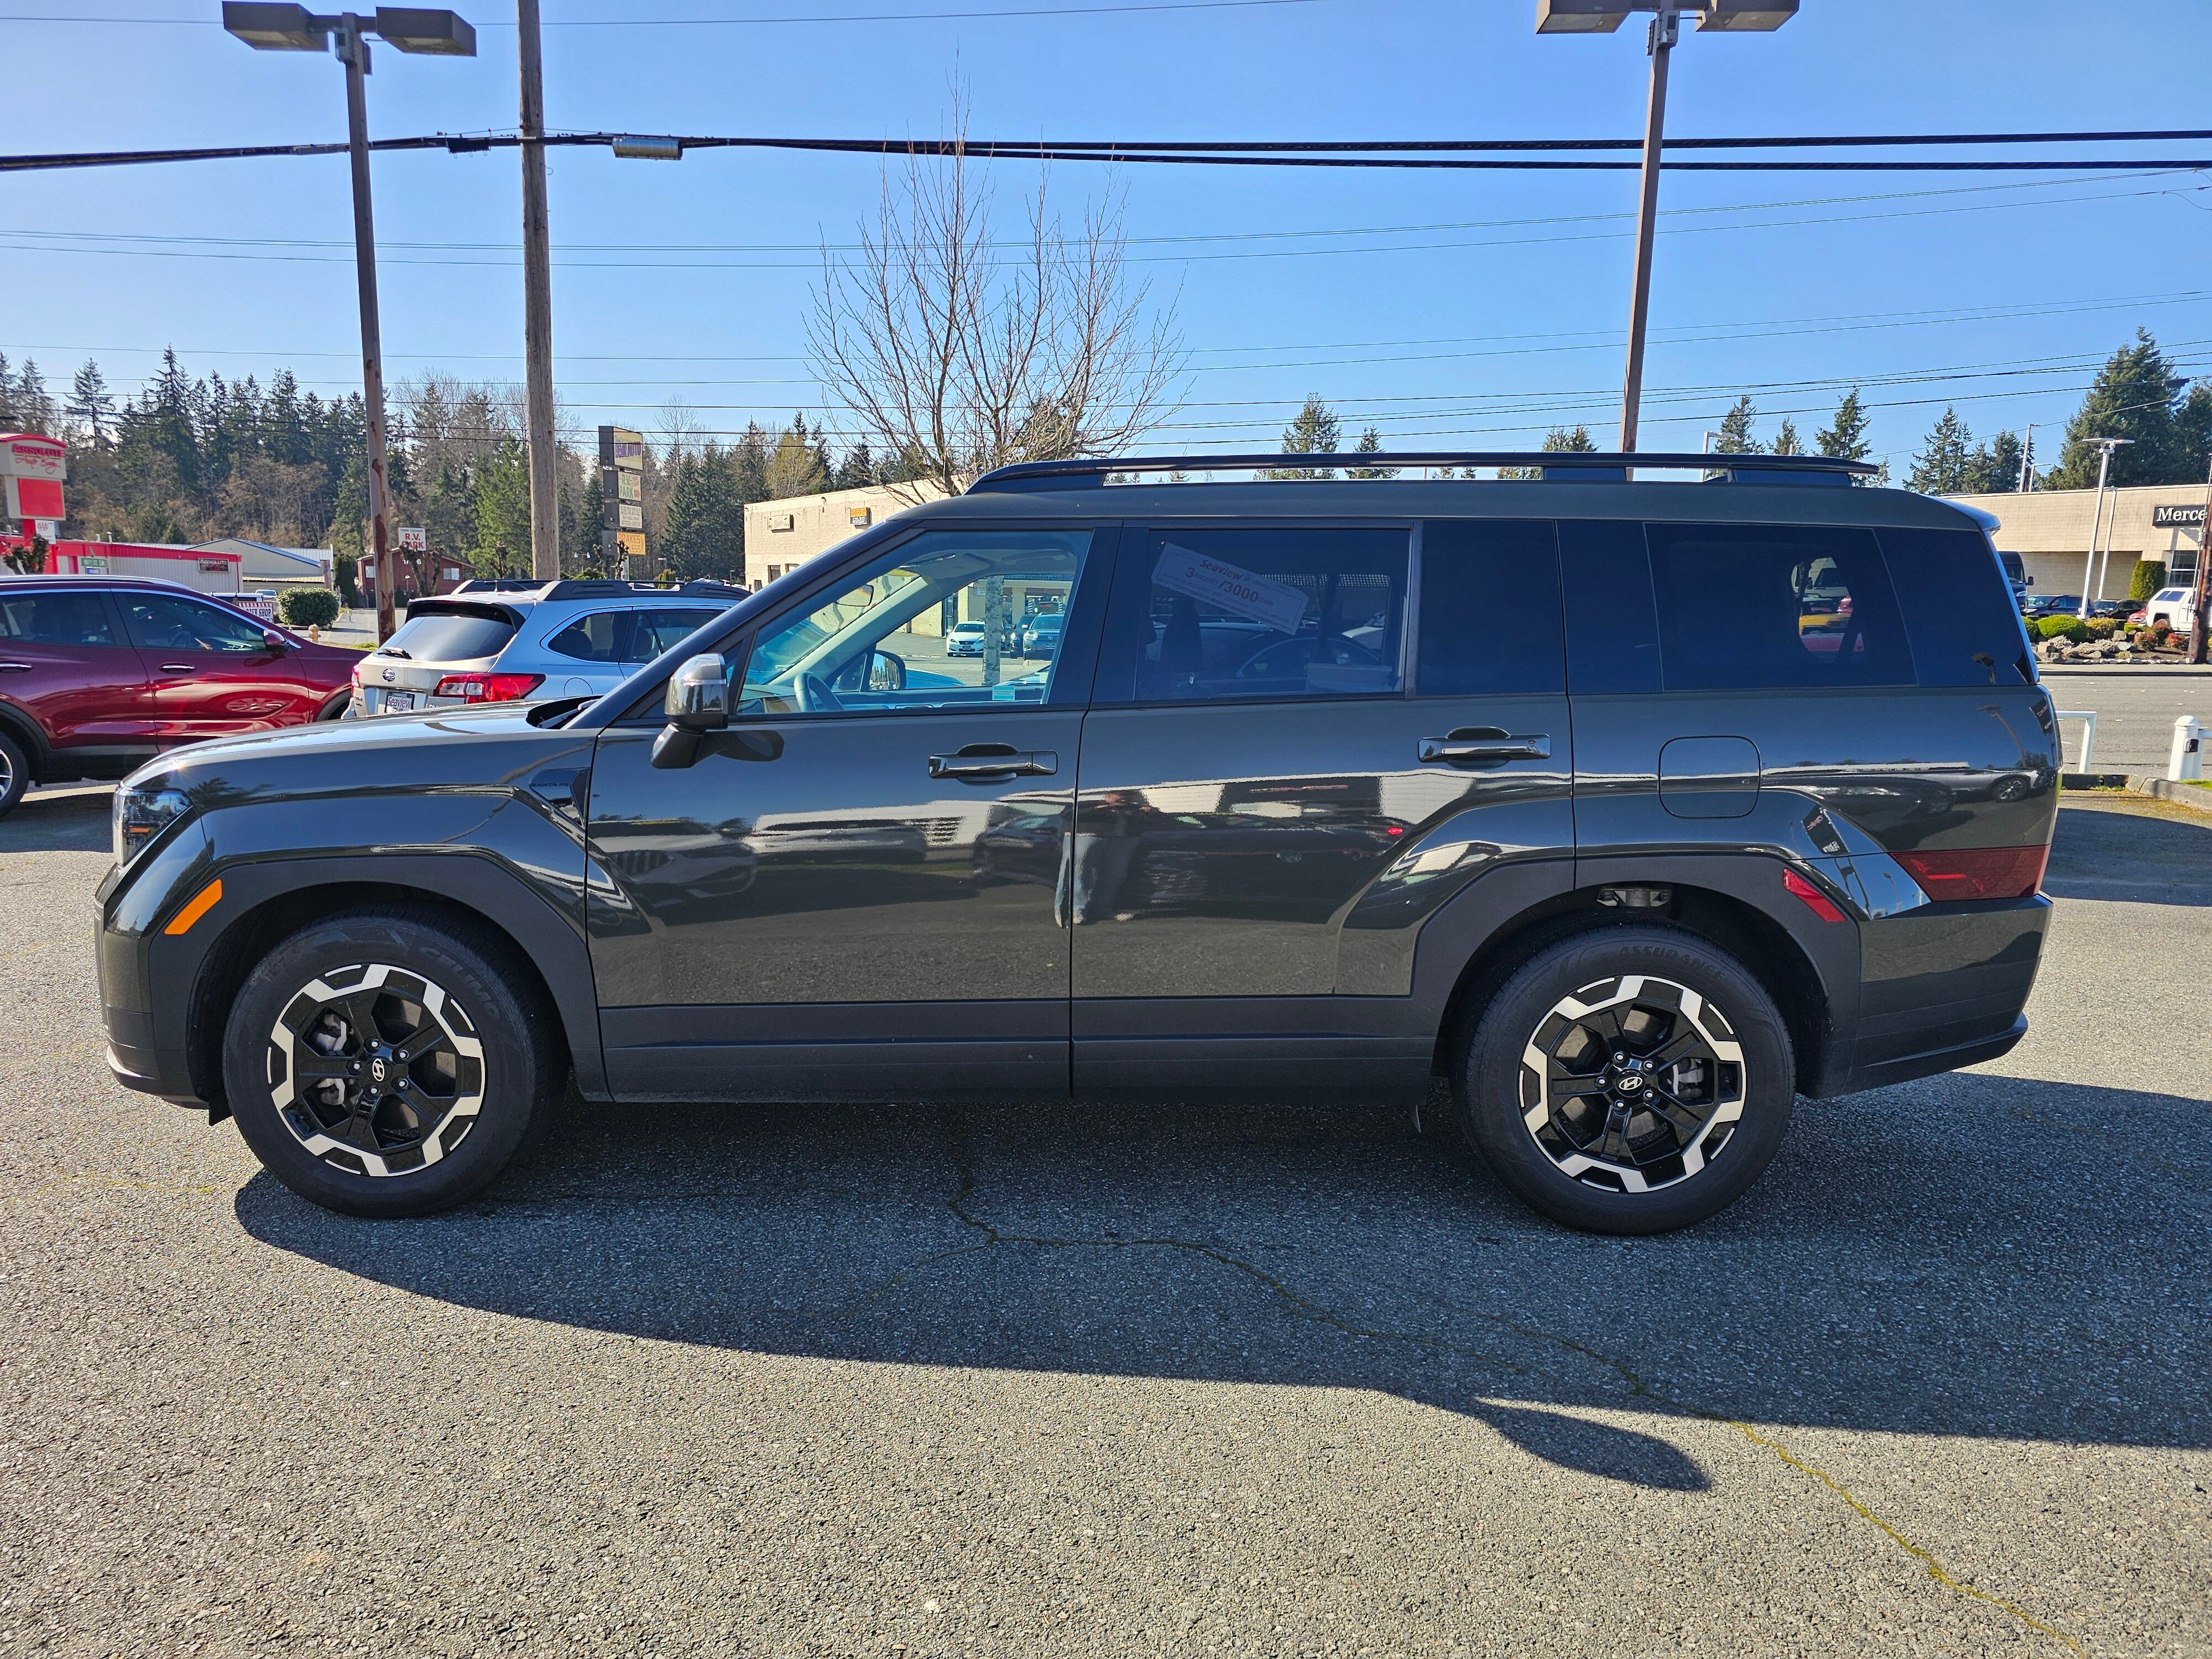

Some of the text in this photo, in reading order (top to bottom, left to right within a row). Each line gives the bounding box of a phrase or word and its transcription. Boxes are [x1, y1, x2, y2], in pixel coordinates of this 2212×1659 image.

[12, 444, 65, 457] ABSOLUTE
[619, 486, 634, 498] PARK
[618, 534, 640, 543] BRAKES
[1199, 559, 1244, 581] Seaview
[259, 608, 271, 617] SHOP
[387, 696, 411, 709] Seaview
[1619, 946, 1726, 979] ASSURANCE
[418, 946, 499, 1020] CELIMO
